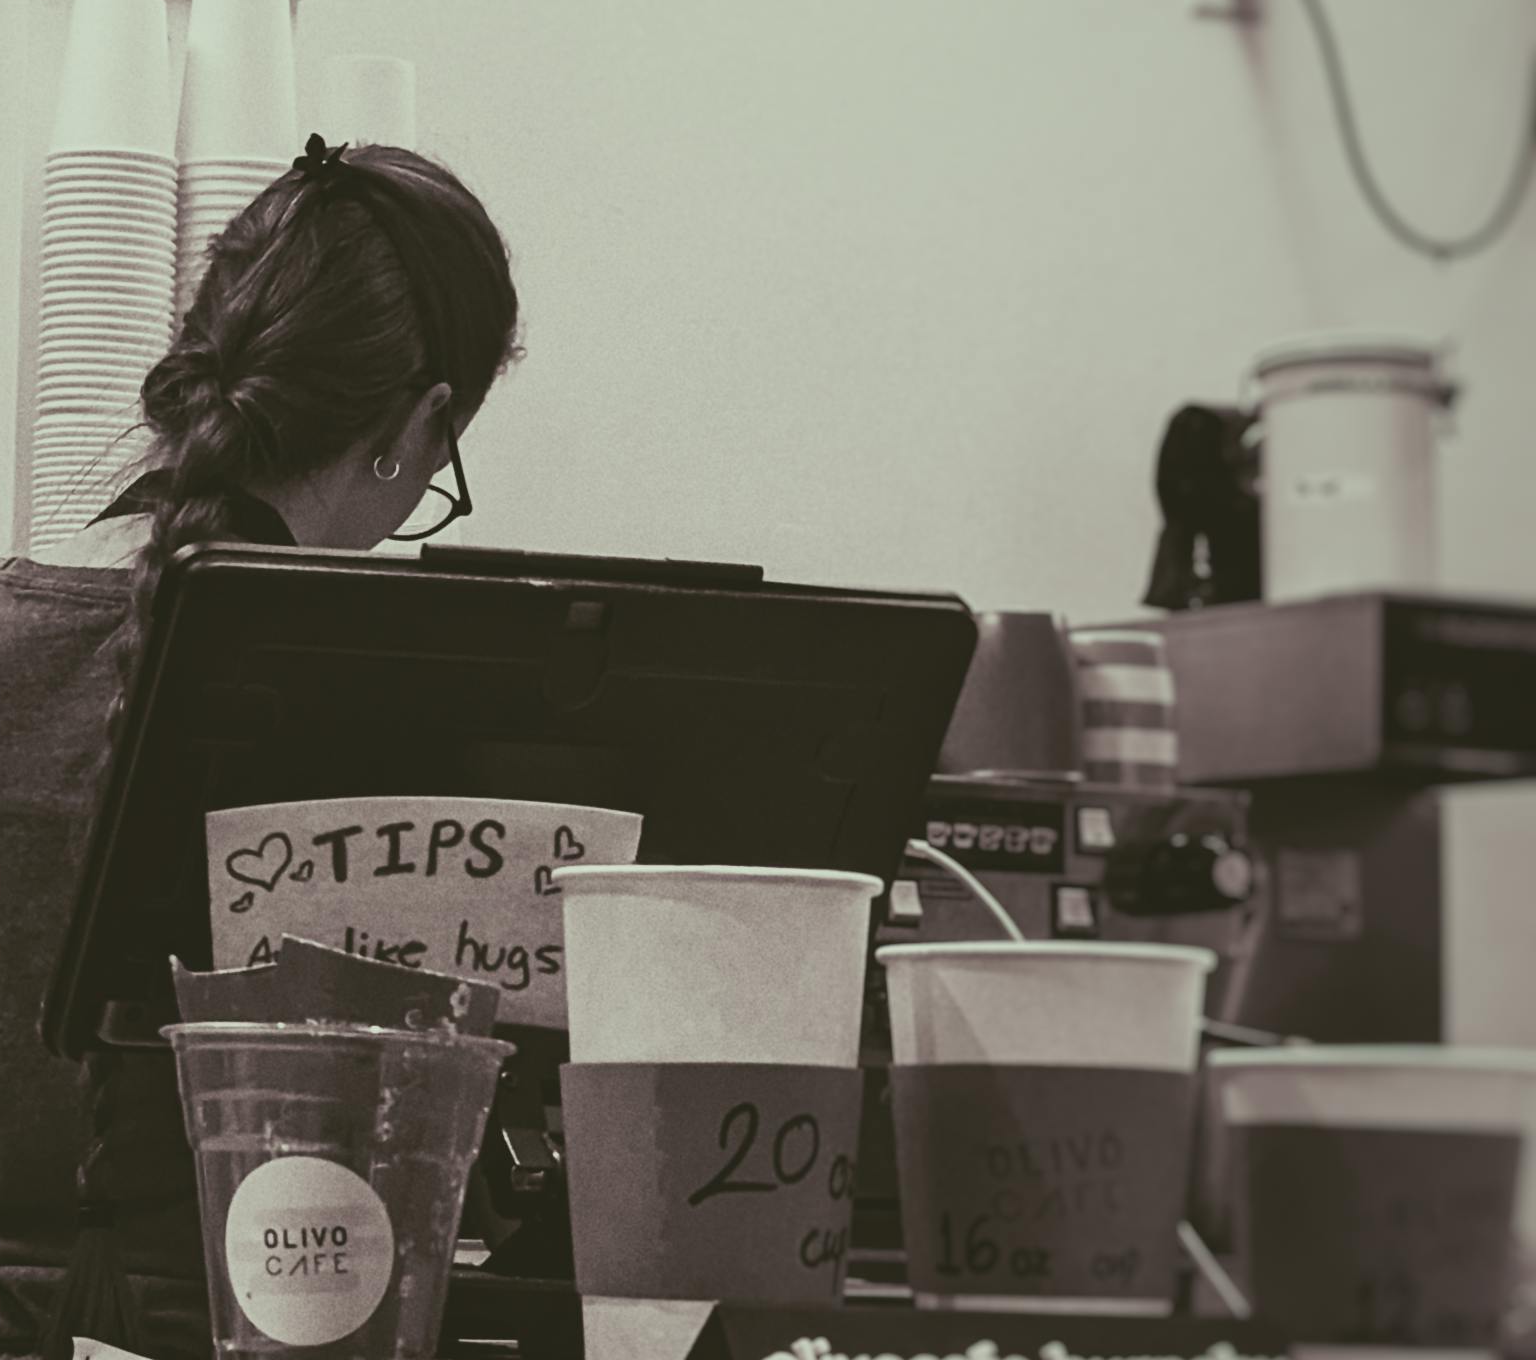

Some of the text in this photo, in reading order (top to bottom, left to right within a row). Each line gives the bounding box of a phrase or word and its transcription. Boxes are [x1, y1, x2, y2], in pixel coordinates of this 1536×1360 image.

[311, 818, 506, 883] TIPS
[344, 926, 428, 969] like
[455, 920, 562, 991] hugs
[687, 1100, 820, 1208] 20
[264, 1225, 348, 1249] OLIVO
[264, 1252, 349, 1276] CAFE
[934, 1210, 1001, 1278] 16
